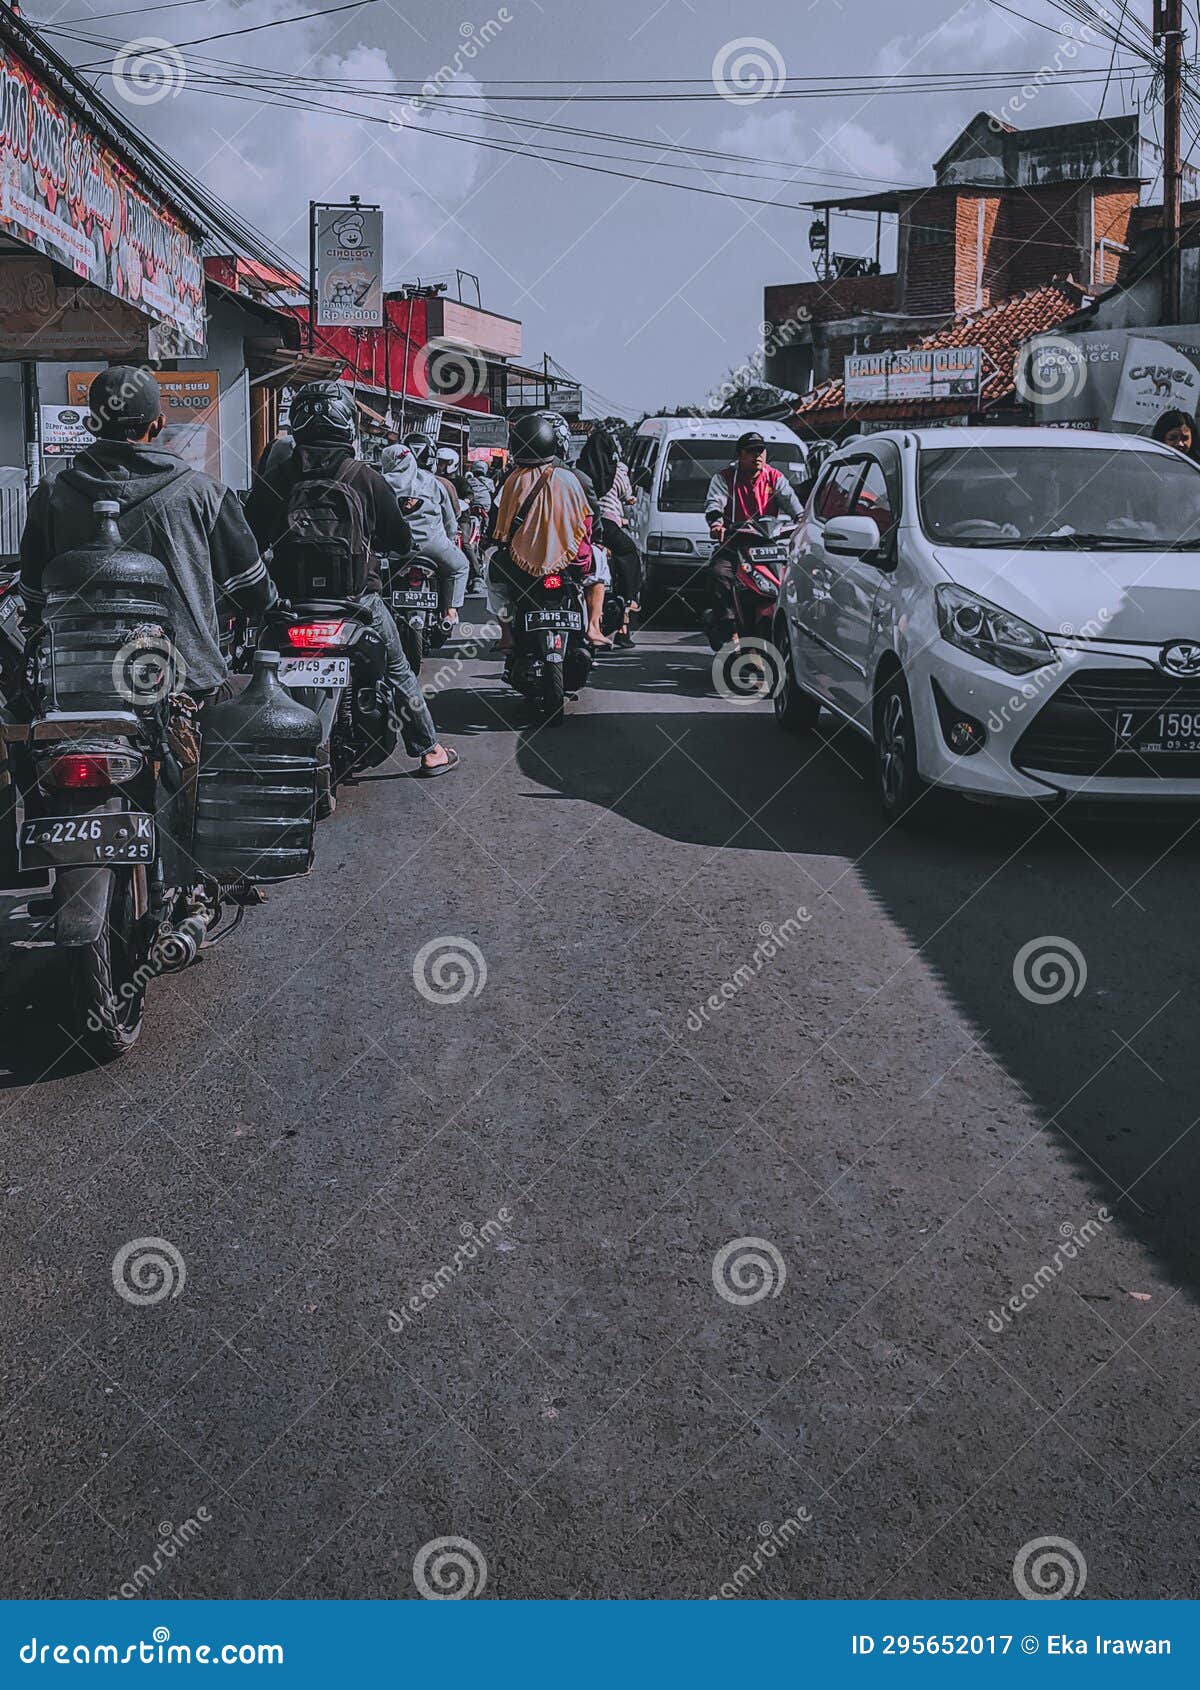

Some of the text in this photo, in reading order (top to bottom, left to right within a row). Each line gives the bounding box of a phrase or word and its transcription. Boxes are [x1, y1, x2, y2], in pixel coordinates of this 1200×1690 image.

[322, 309, 378, 321] Rp 6.000
[1086, 343, 1110, 352] NEW
[1037, 351, 1121, 367] LOOONGER
[1128, 364, 1195, 388] CAMEL
[185, 382, 210, 391] SUSU
[169, 396, 211, 408] 3.000
[1120, 712, 1133, 737] Z
[25, 818, 150, 845] Z 2246 K
